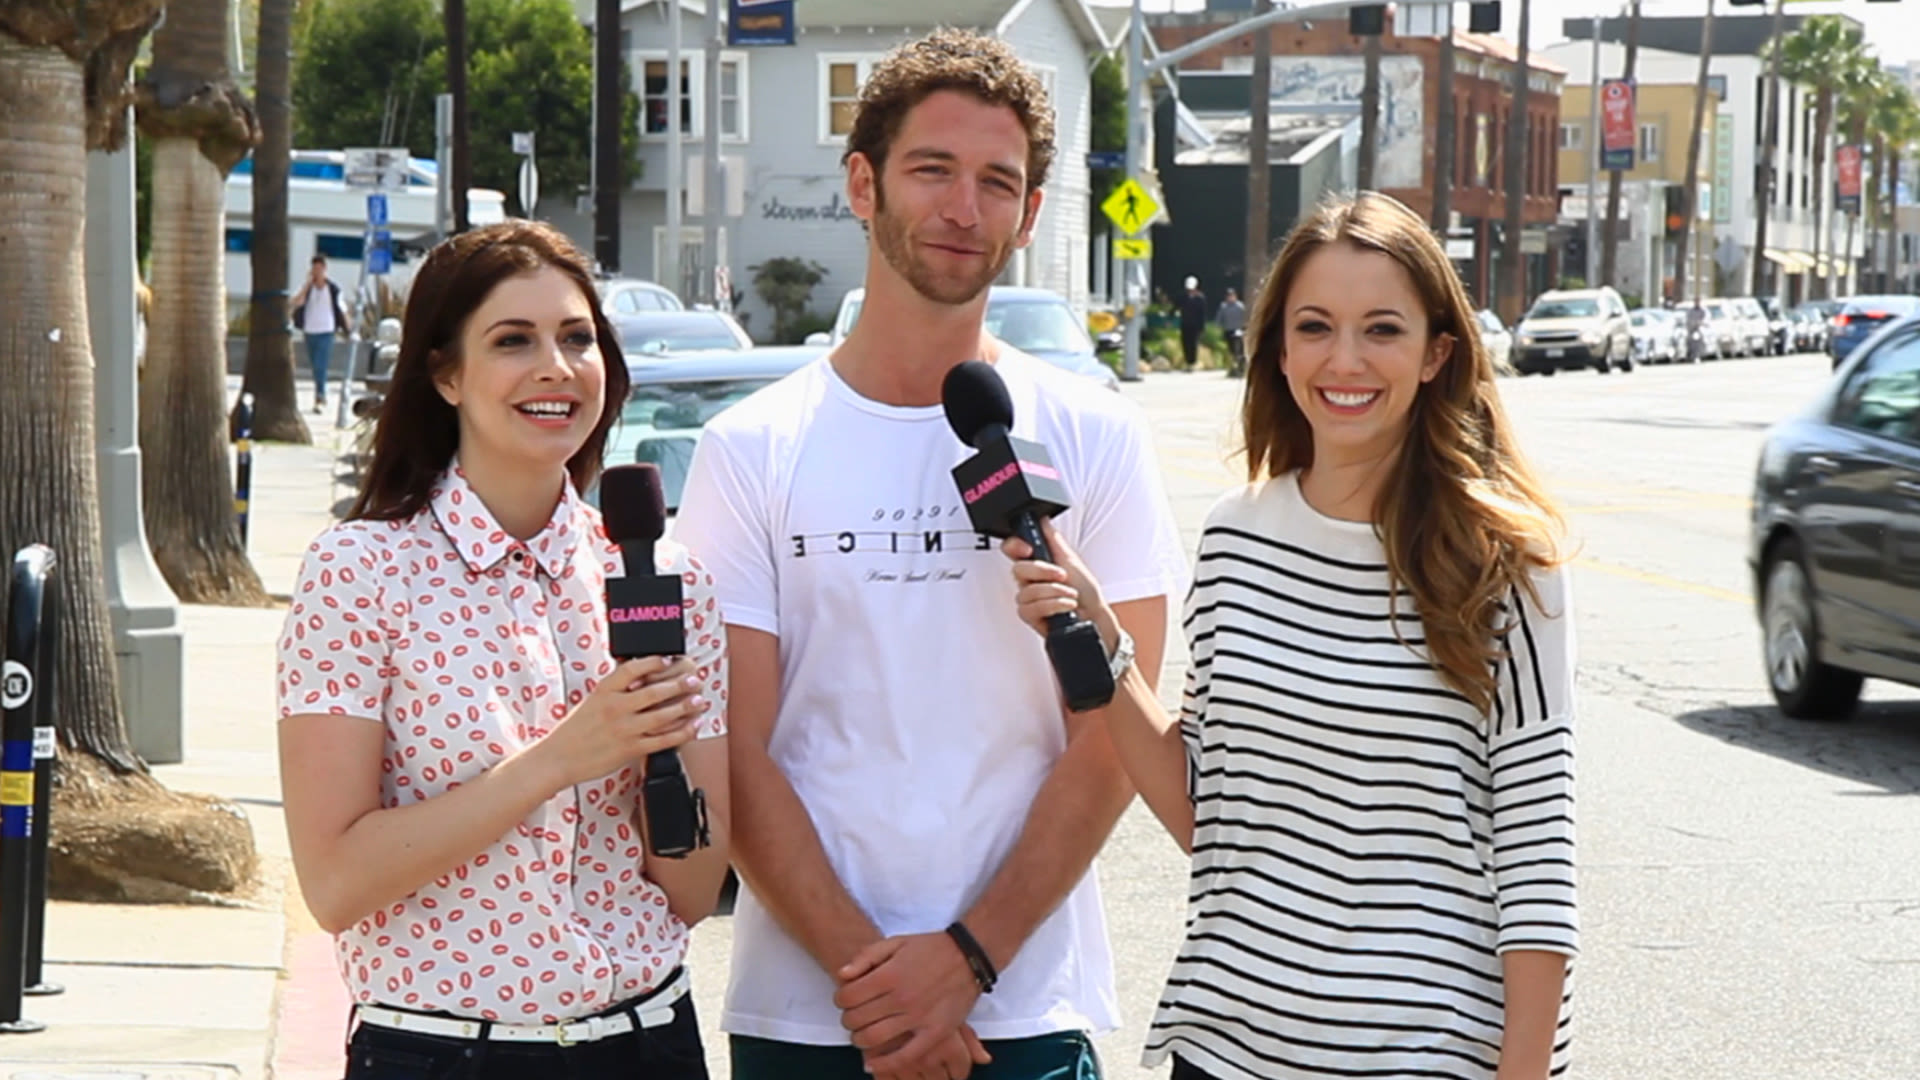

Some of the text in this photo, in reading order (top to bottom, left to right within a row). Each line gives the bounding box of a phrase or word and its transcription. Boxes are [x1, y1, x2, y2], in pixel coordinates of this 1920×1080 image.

[820, 191, 857, 221] ala
[963, 461, 1019, 504] GLAMOUR
[872, 505, 959, 522] 90291
[609, 604, 681, 622] GLAMOUR
